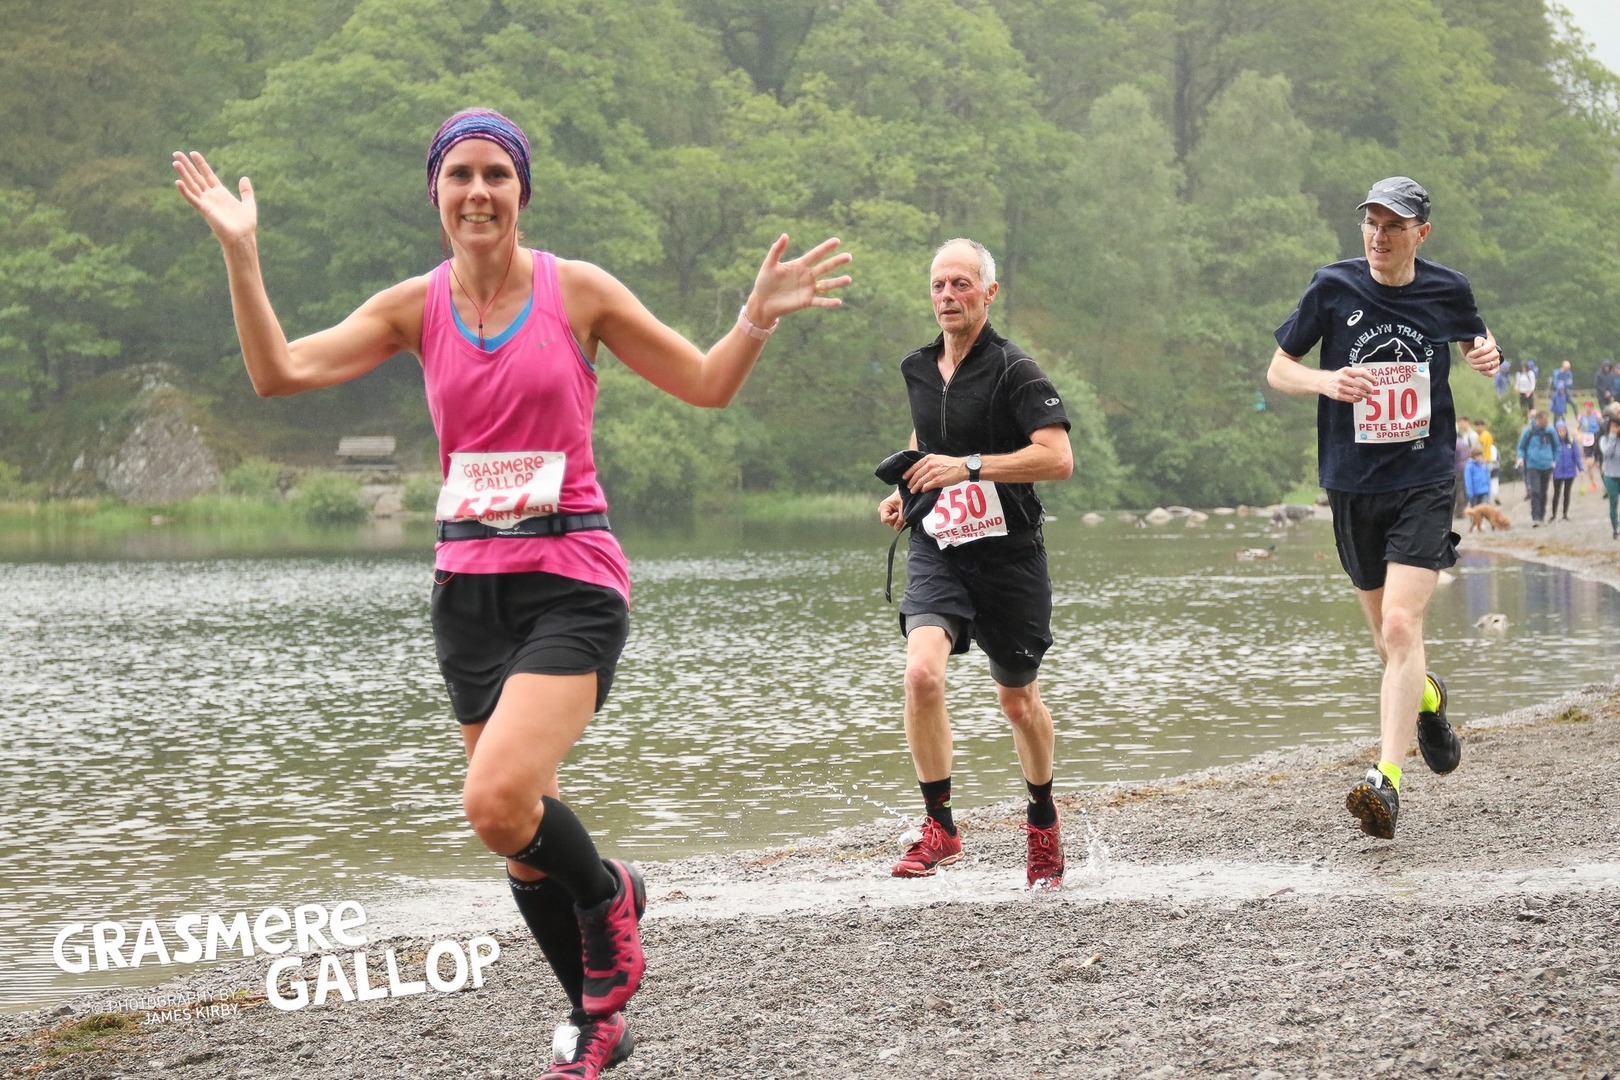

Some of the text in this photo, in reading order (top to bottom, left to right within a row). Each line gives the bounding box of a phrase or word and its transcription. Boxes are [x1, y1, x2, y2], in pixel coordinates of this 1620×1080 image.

[1349, 324, 1392, 365] HELVELLYN
[1396, 324, 1424, 345] TRAIL
[1365, 387, 1418, 422] 510
[1359, 419, 1428, 432] PETE BLAND
[1376, 430, 1411, 439] SPORTS
[474, 472, 534, 492] GALLOP
[934, 483, 987, 530] 550
[961, 517, 1003, 533] BLAND
